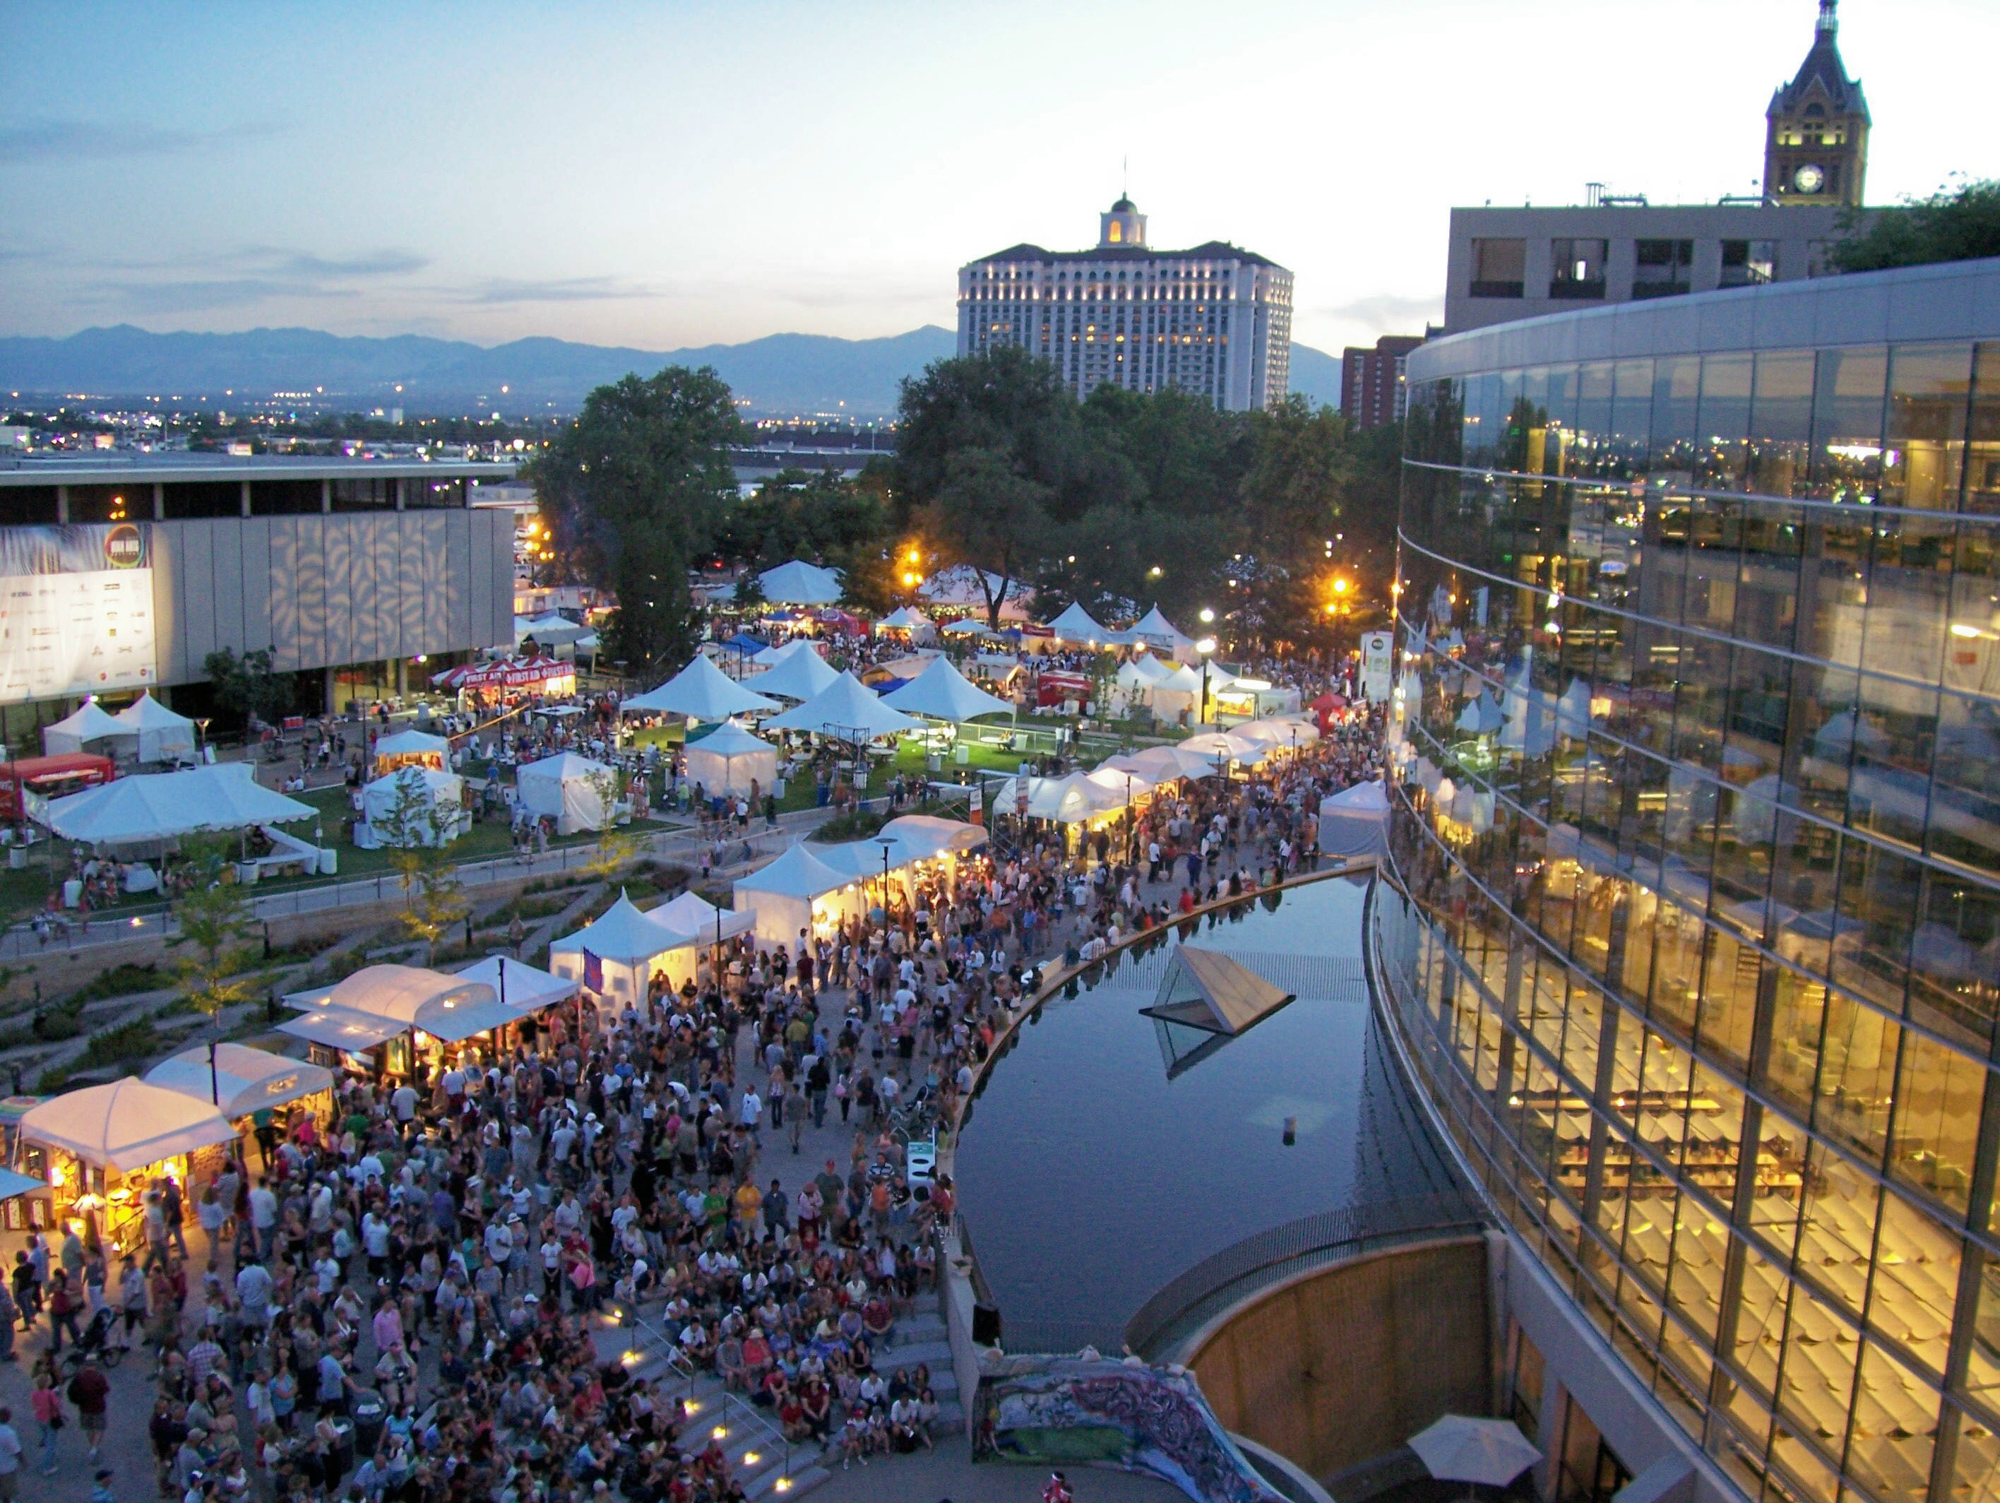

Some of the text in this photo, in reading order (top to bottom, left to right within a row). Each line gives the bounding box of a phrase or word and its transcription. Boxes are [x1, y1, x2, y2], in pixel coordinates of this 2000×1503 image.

[466, 673, 487, 684] FIRST
[511, 670, 540, 683] FIRST AID
